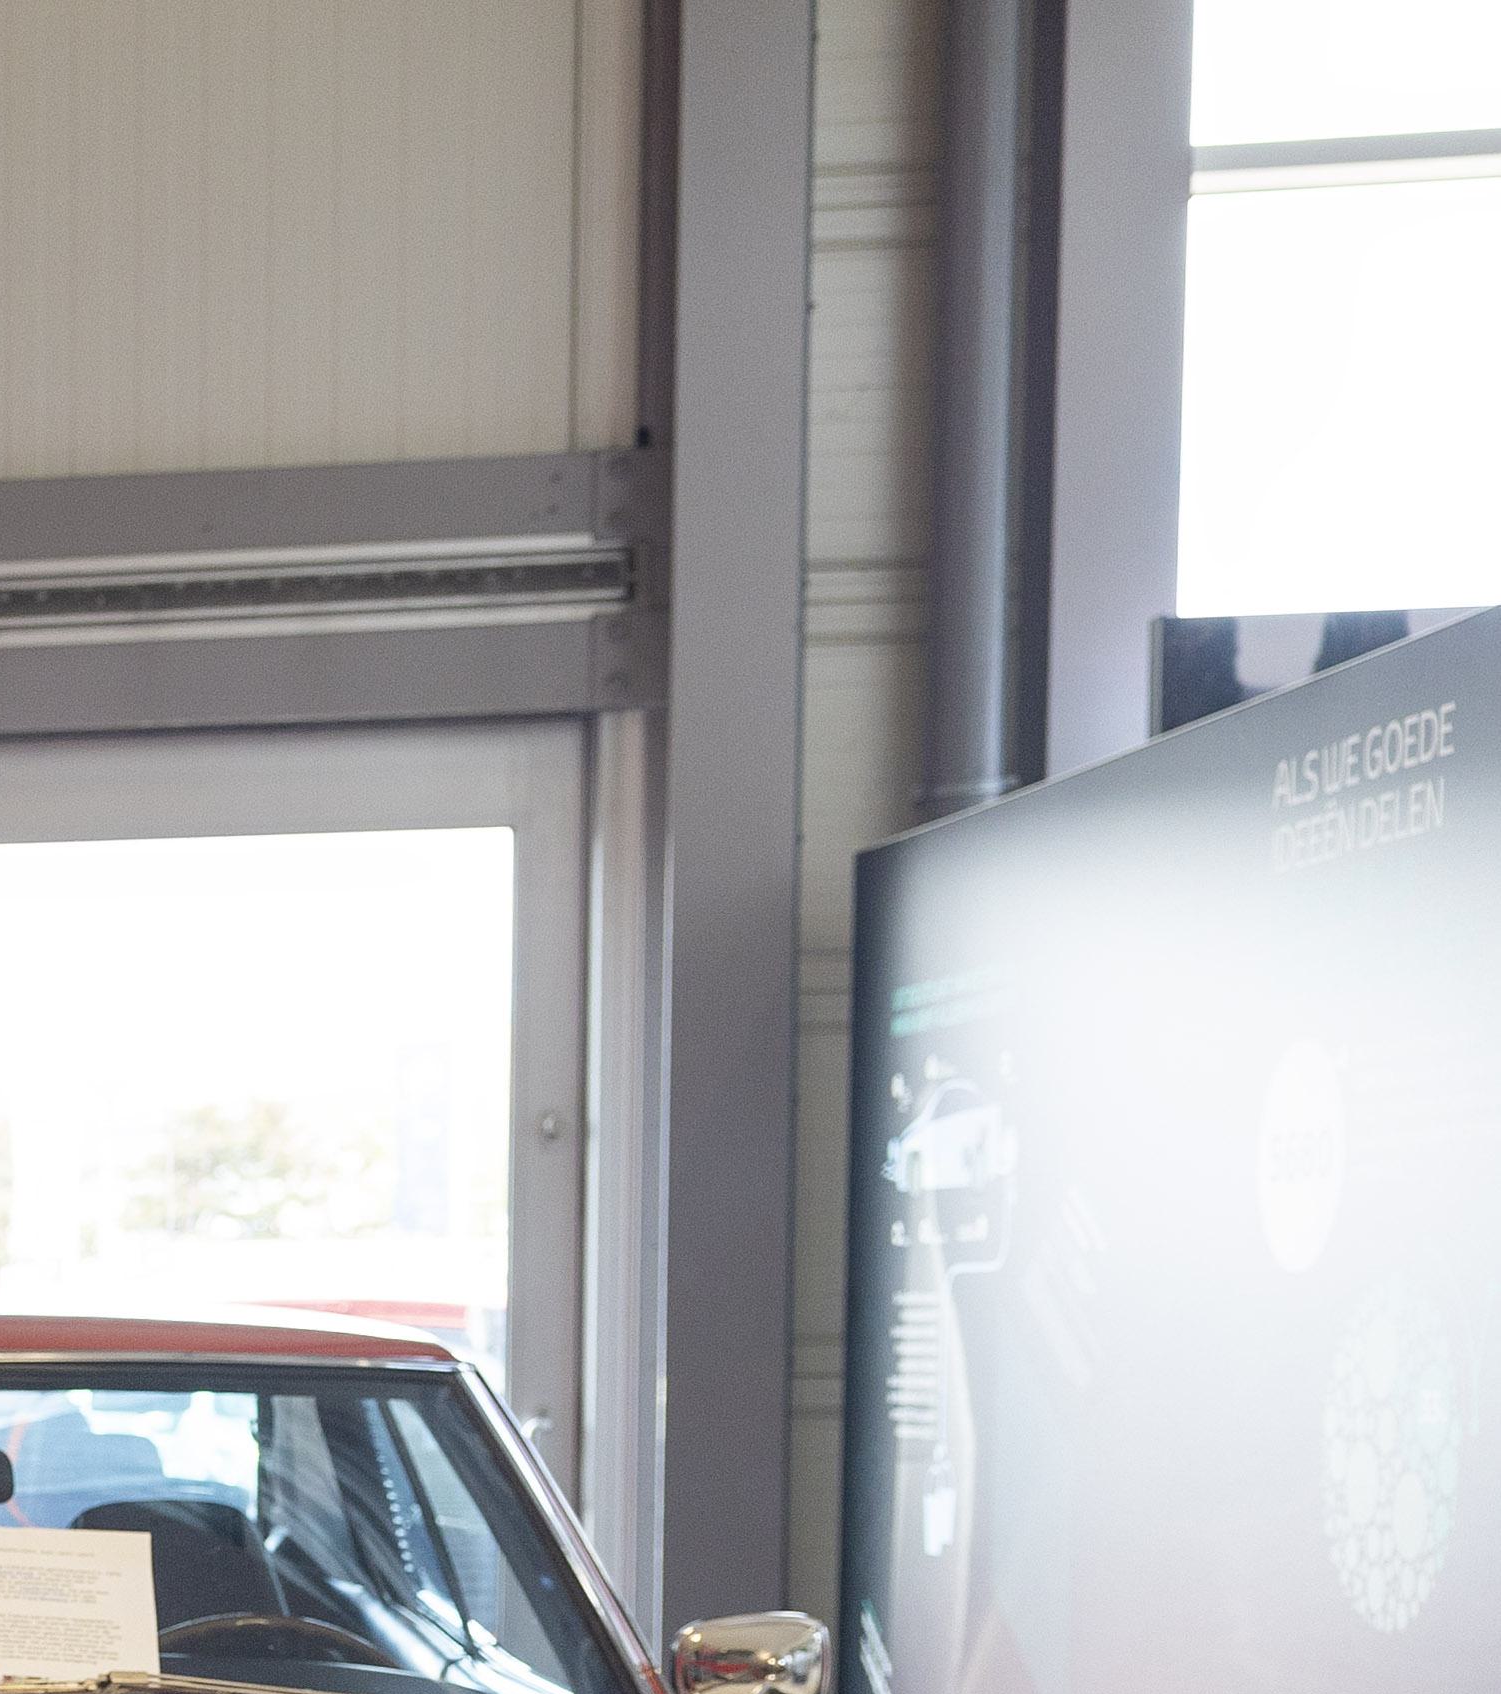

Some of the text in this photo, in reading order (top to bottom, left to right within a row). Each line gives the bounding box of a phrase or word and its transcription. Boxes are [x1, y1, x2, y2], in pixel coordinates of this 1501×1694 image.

[1272, 698, 1459, 810] ALS WE GOEDE
[1358, 774, 1446, 850] DELEN
